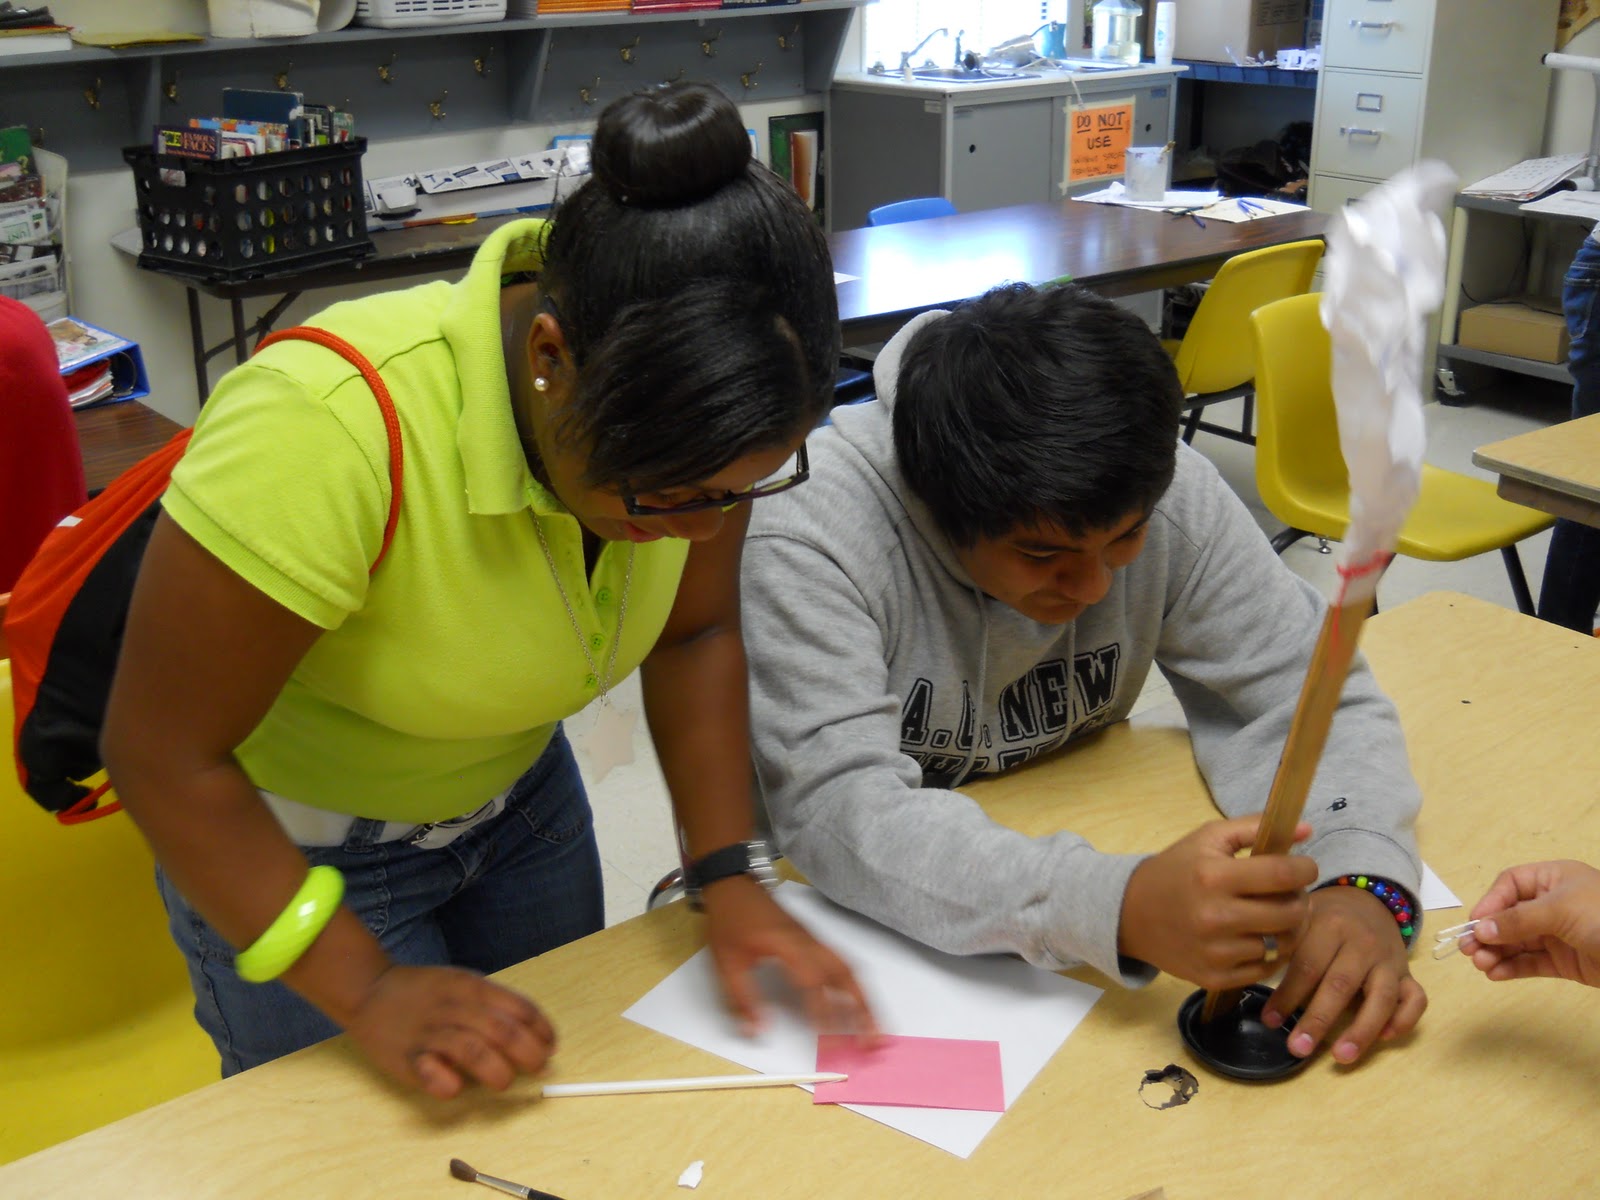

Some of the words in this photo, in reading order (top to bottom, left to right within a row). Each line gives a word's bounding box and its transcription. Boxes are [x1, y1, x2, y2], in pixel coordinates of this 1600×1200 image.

[1076, 115, 1091, 128] DO
[1098, 111, 1126, 127] NOT
[184, 140, 215, 152] FACES
[1087, 135, 1112, 150] USE
[999, 642, 1121, 743] NEW
